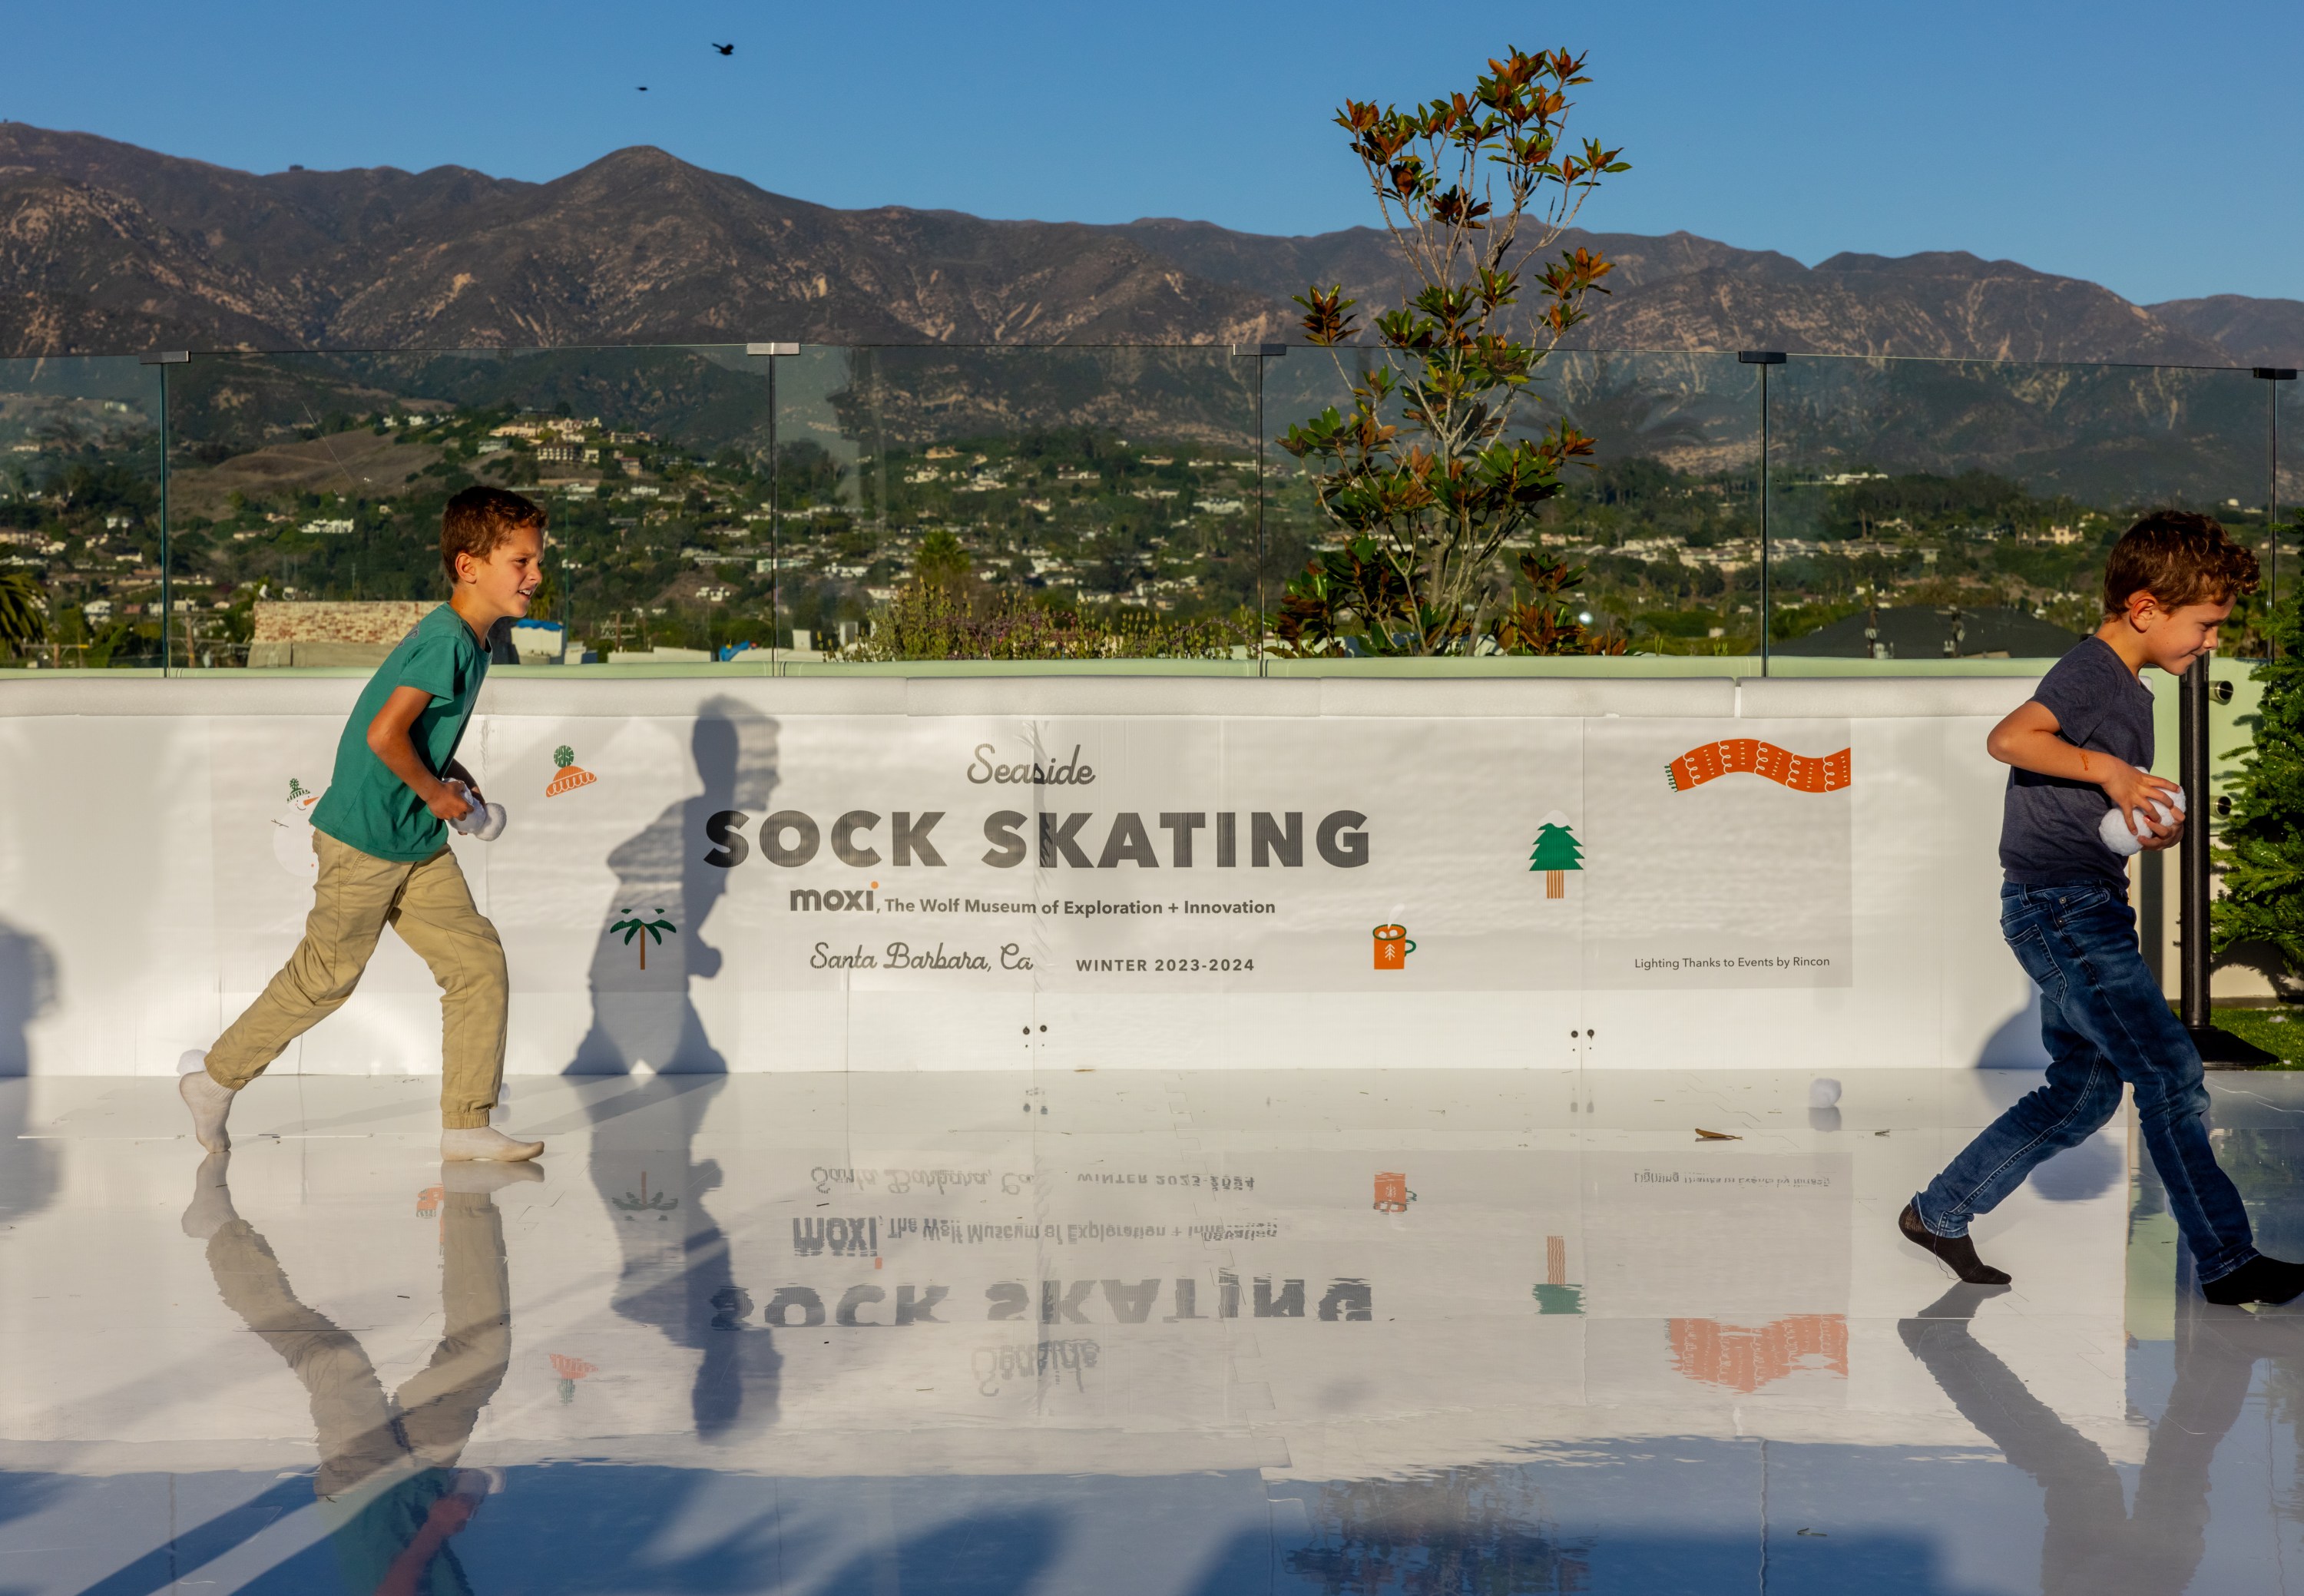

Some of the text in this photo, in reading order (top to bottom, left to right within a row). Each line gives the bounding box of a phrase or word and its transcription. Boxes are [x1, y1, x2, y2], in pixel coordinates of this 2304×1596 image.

[966, 743, 1096, 786] Seaside
[703, 810, 1369, 869] SOCK SKATING
[884, 898, 915, 912] The
[919, 897, 960, 912] Wolf
[965, 899, 1037, 914] Museum
[1041, 900, 1060, 914] of
[1064, 900, 1163, 918] Exploration
[1167, 902, 1179, 914] +
[1184, 899, 1276, 914] Innovation
[809, 942, 1034, 972] Santa Barbara, Ca
[1076, 959, 1255, 972] WINTER 2023-2024
[1634, 956, 1830, 971] Lighting Thanks to Events by Rincon
